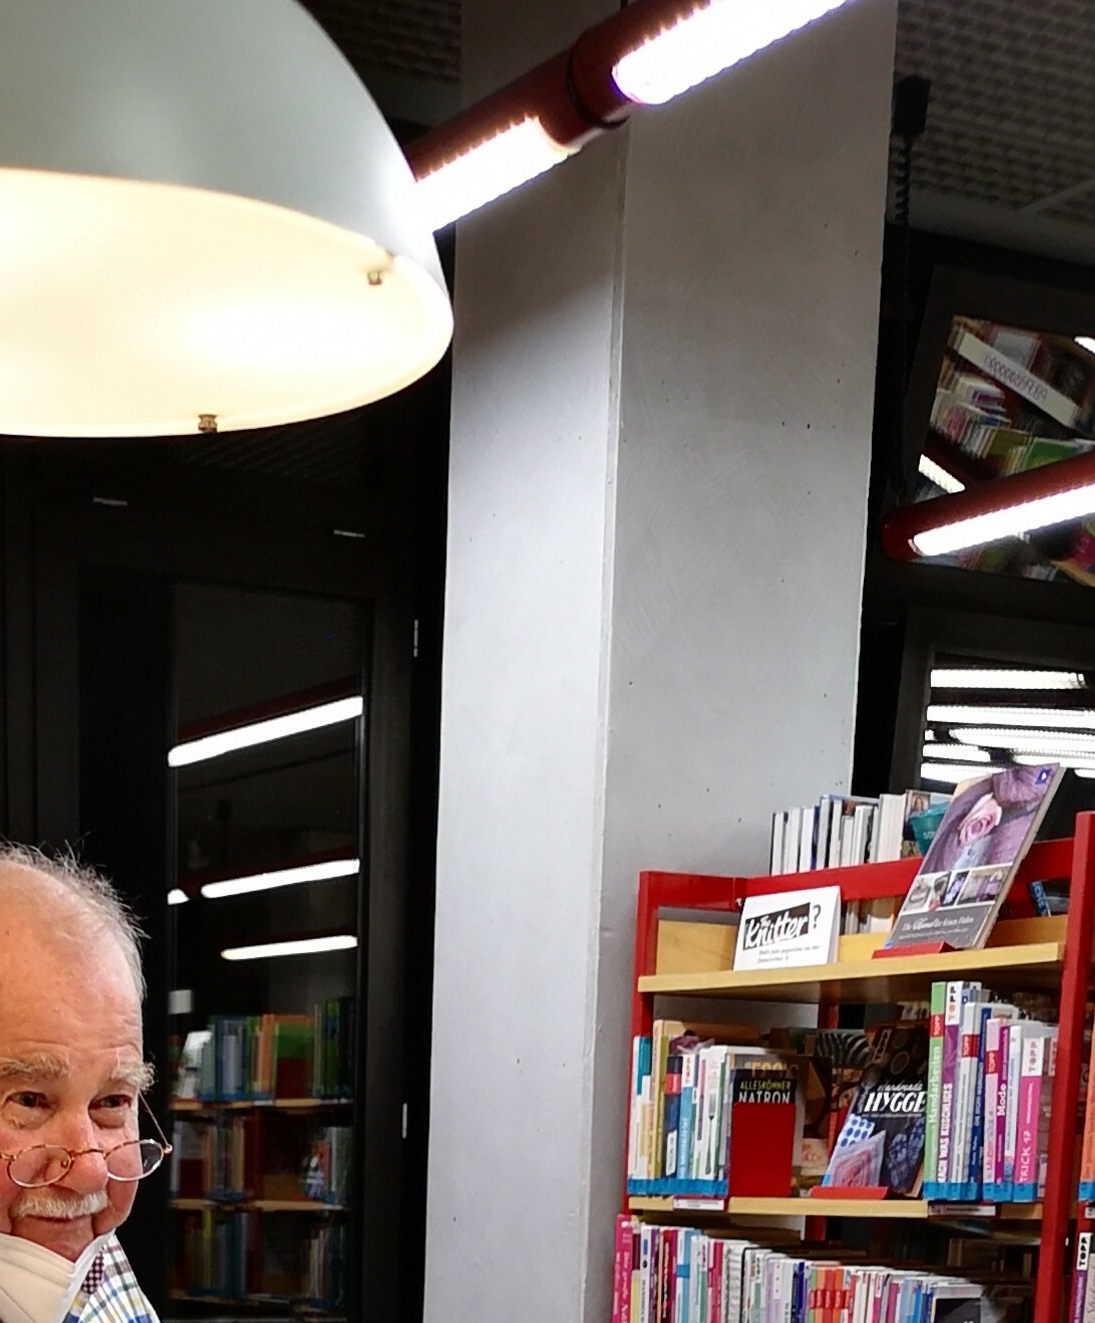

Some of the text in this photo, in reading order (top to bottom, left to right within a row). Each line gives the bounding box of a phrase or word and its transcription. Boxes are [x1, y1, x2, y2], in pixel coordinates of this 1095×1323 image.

[745, 912, 808, 948] Knitter
[739, 1091, 790, 1104] NATRON
[864, 1091, 926, 1112] HYGGE
[928, 1047, 940, 1123] Handarbeiten
[997, 1083, 1006, 1116] Mode
[941, 1083, 952, 1136] KUSCHLIGES
[940, 1138, 949, 1158] WAS
[1020, 1147, 1030, 1182] TRICK
[1079, 1237, 1087, 1266] TOPP
